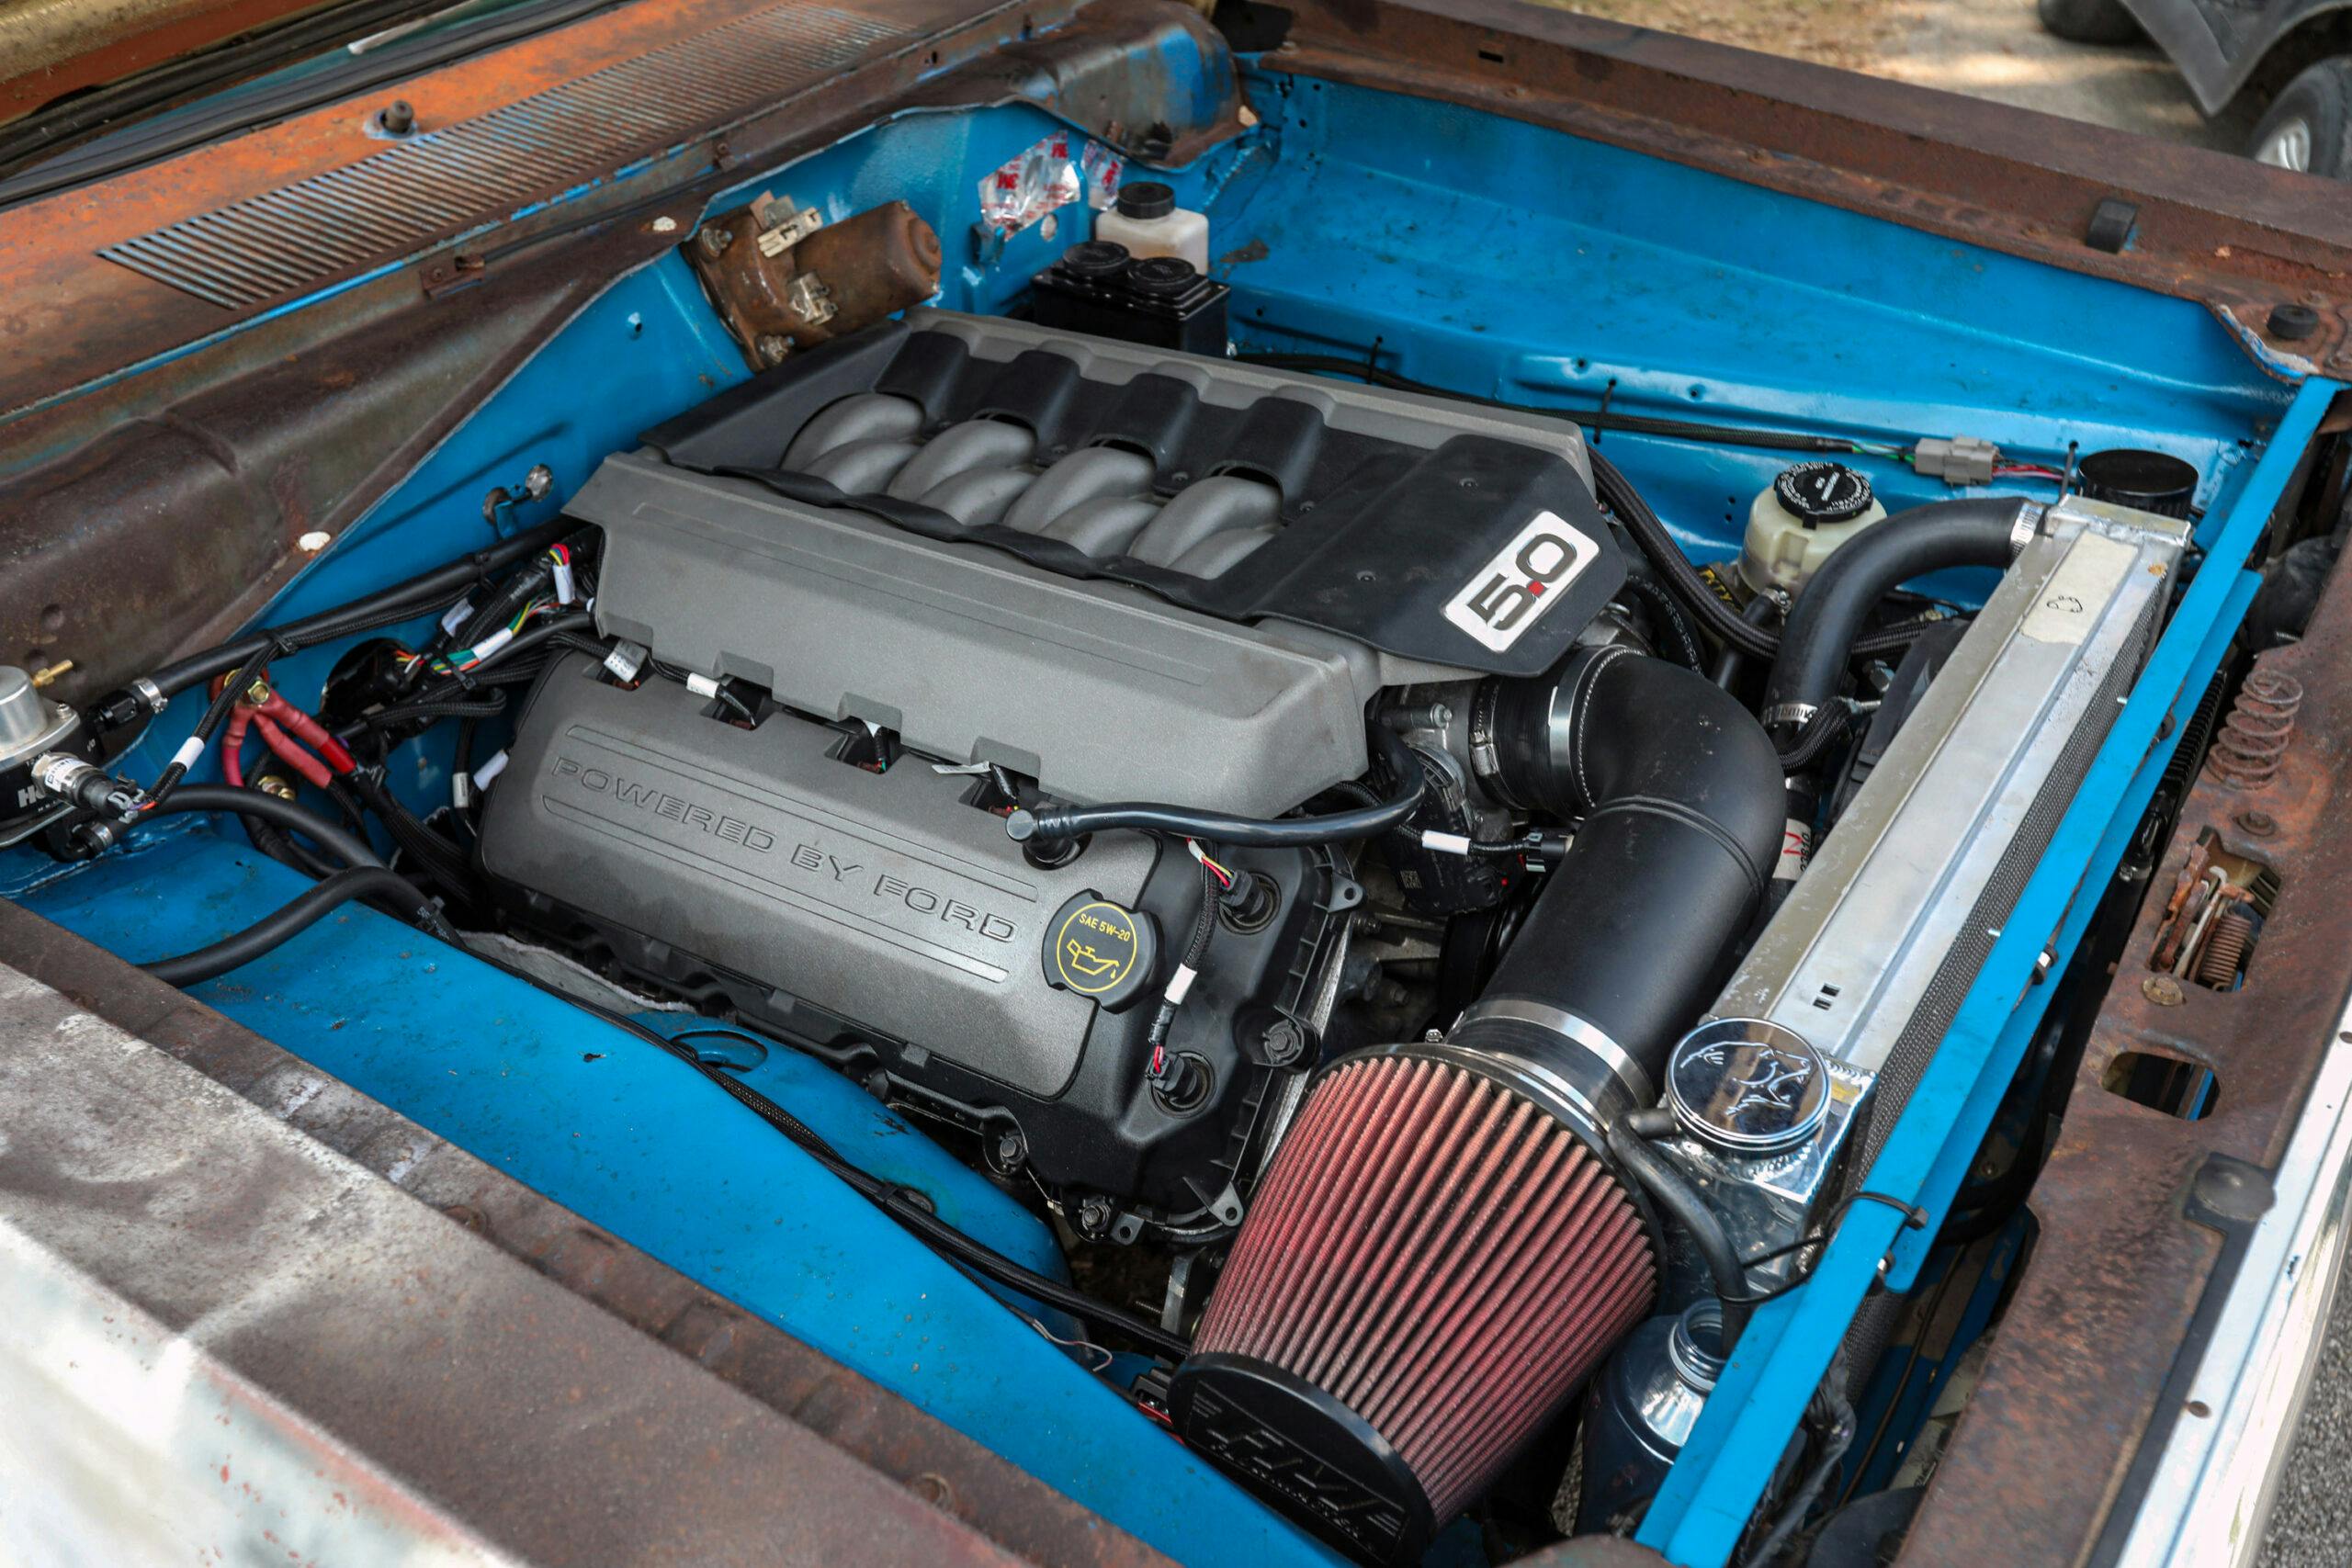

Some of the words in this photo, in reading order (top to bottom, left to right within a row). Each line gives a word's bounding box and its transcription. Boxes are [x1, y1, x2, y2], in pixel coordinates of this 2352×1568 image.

[1466, 533, 1578, 632] 5.0
[552, 756, 778, 852] POWERED
[789, 843, 865, 883] BY
[874, 874, 1021, 943] FORD
[1080, 914, 1098, 929] SAE
[1099, 921, 1130, 942] 5W-20
